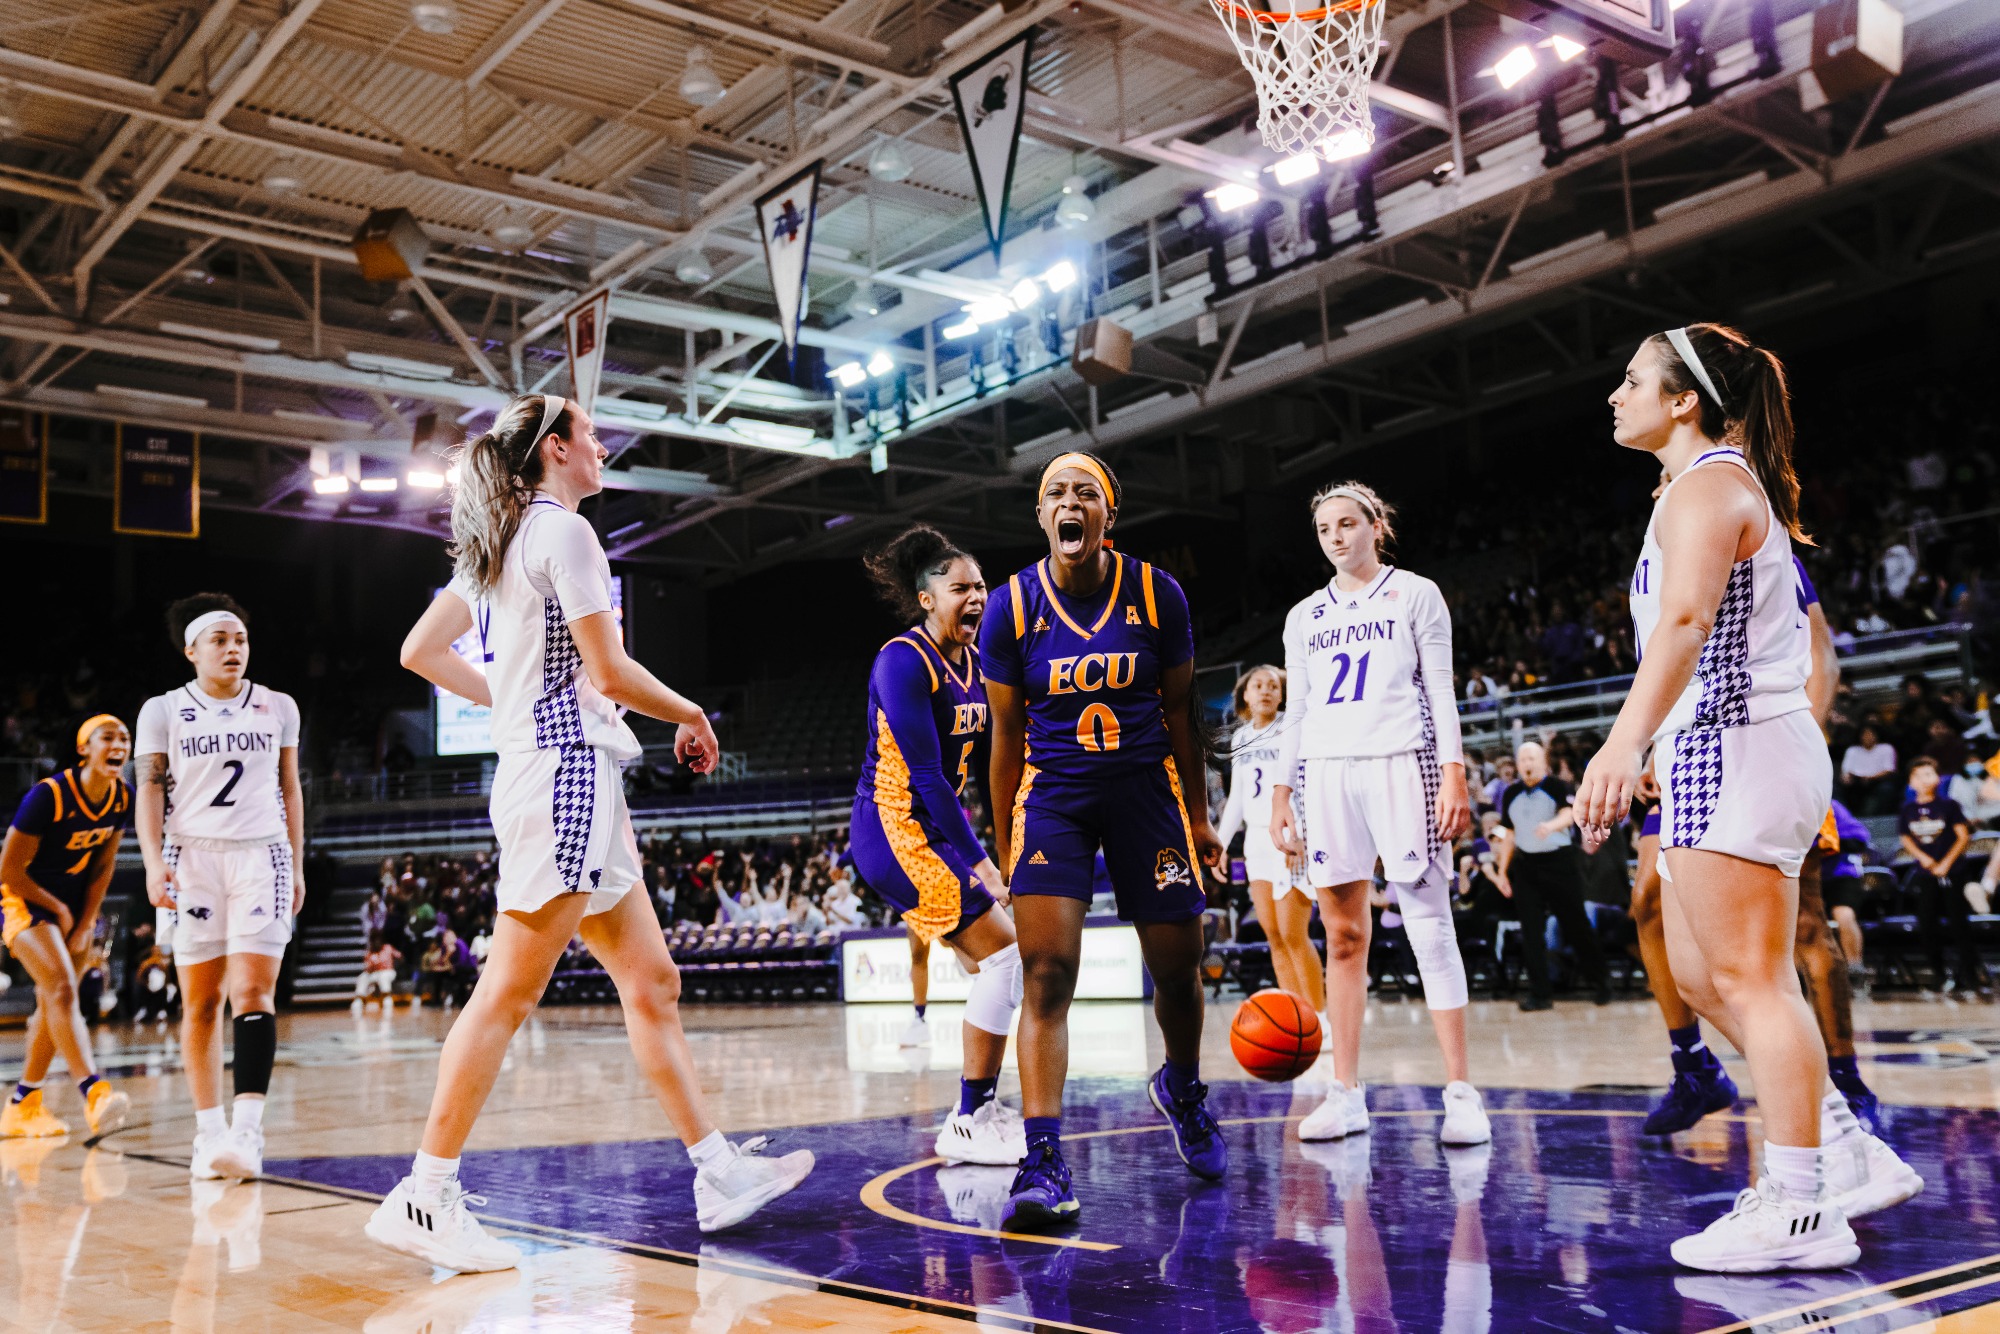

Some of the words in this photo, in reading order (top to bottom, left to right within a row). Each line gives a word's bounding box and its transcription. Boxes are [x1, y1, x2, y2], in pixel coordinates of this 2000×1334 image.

[1308, 627, 1342, 656] HIGH
[1345, 619, 1396, 644] POINT
[1047, 652, 1140, 696] ECU
[1325, 649, 1371, 705] 21
[949, 702, 988, 735] ECU
[1076, 702, 1120, 752] 0
[180, 734, 220, 758] HIGH
[227, 732, 273, 753] POINT
[209, 759, 244, 807] 2
[955, 740, 975, 797] 5
[1252, 767, 1263, 799] 3
